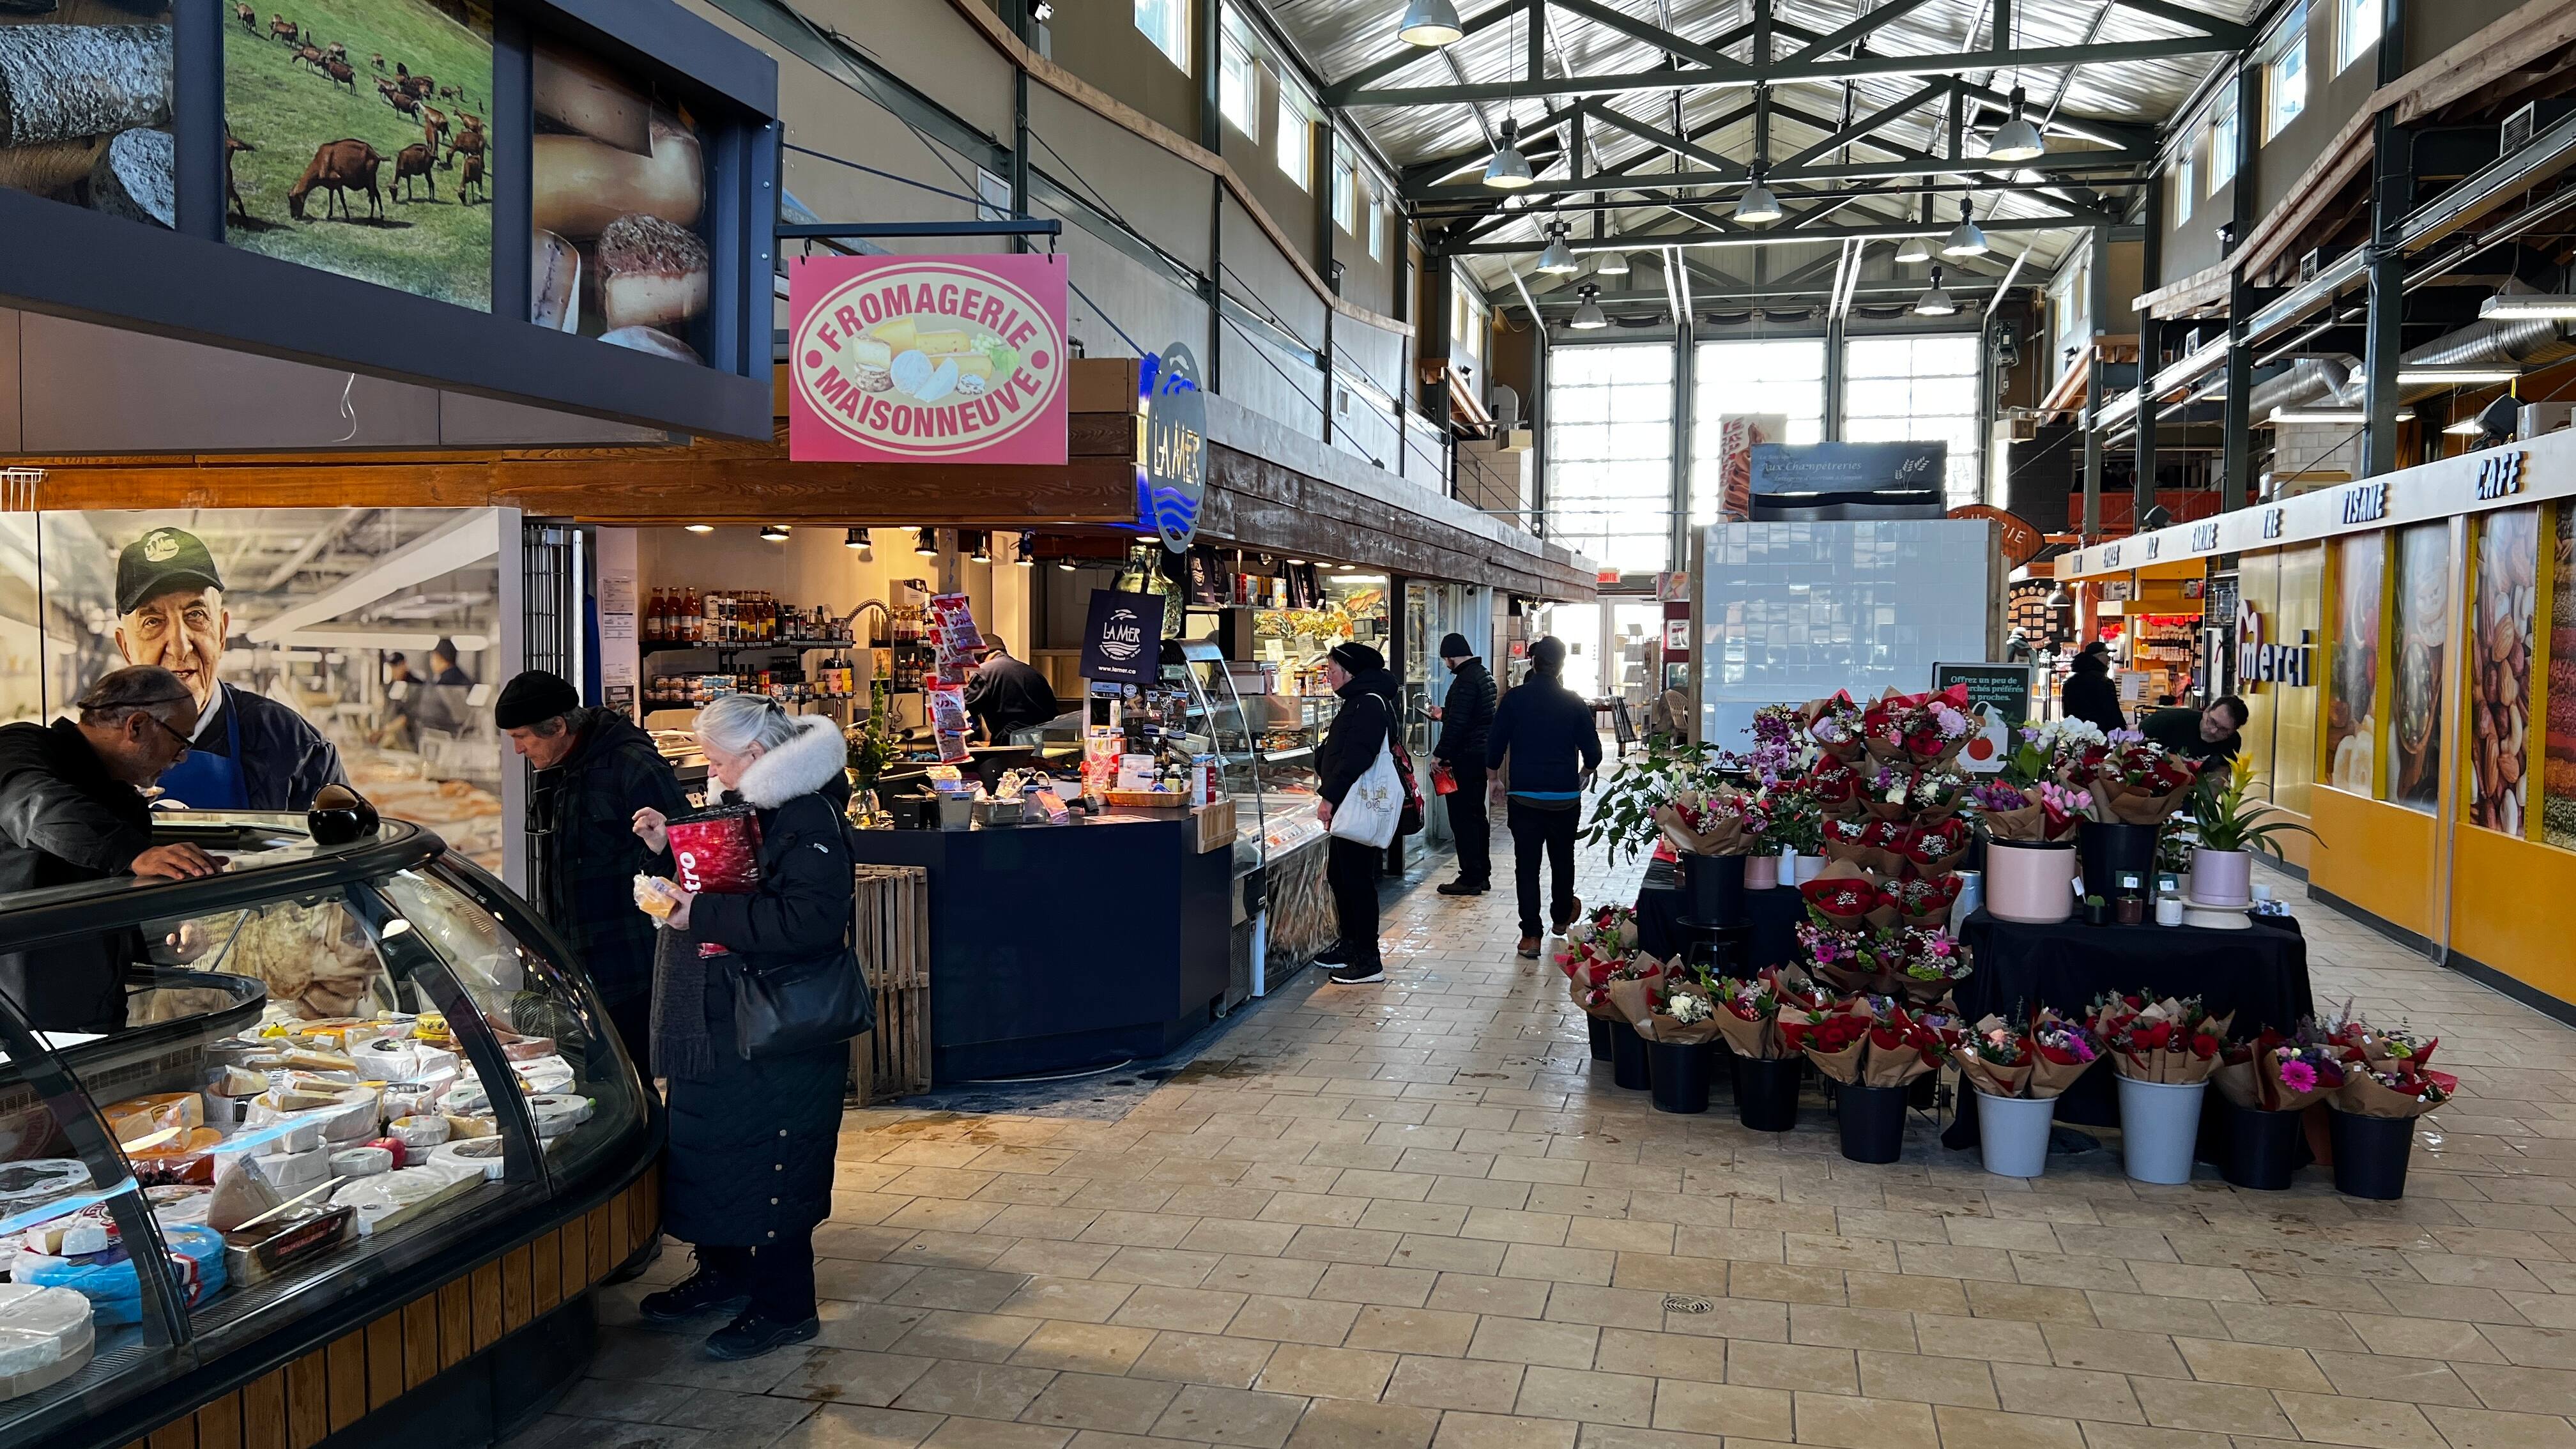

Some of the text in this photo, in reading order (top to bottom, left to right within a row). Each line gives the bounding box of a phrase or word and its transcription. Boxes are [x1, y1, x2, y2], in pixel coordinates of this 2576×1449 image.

[816, 283, 1038, 353] FROMAGERIE
[813, 365, 1042, 438] MAISONNEUVE
[1154, 412, 1200, 487] LA MER
[1759, 461, 1786, 471] Aux
[2342, 482, 2389, 524] TISANE
[1103, 622, 1140, 643] LA MER
[1993, 685, 2024, 693] préférés
[679, 851, 702, 892] tro
